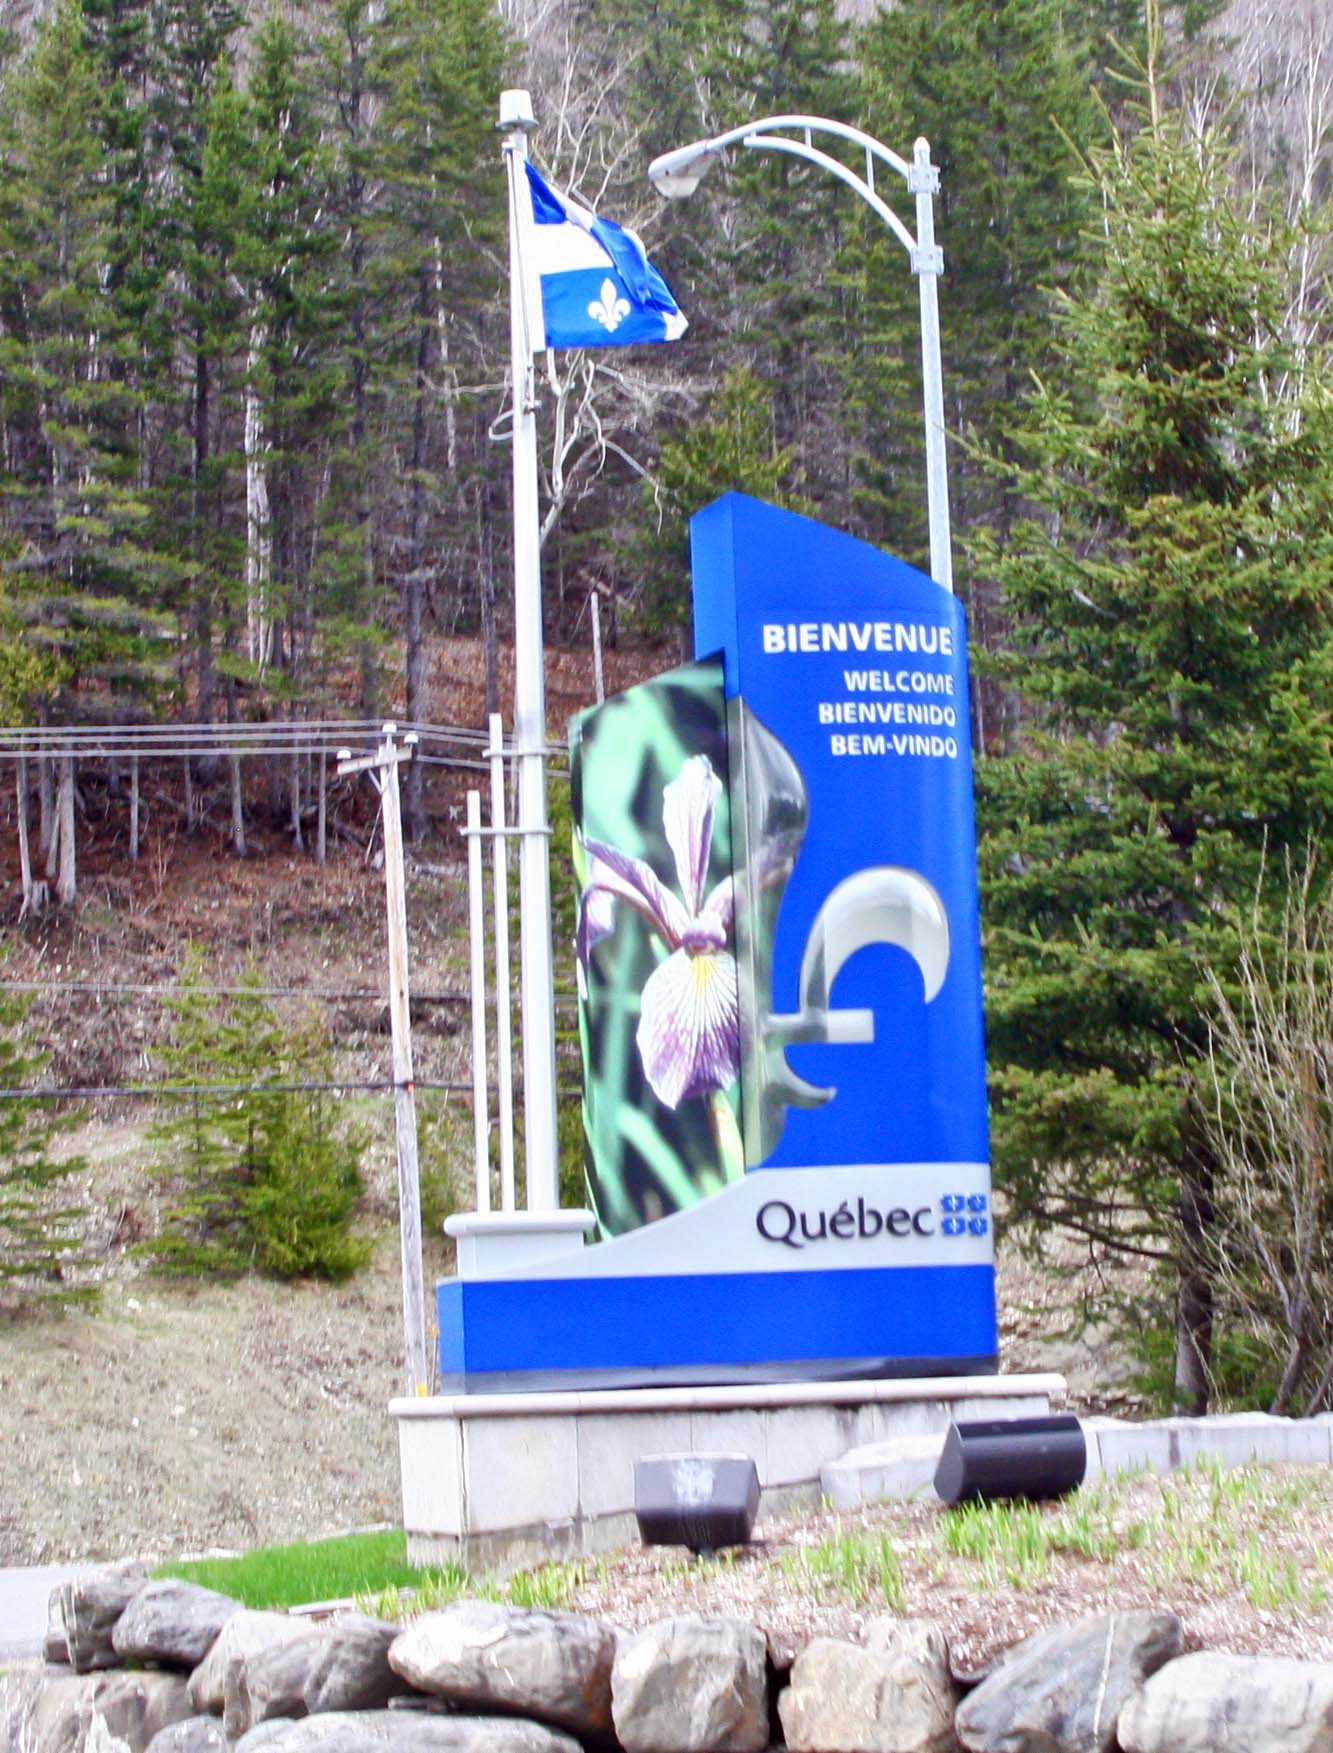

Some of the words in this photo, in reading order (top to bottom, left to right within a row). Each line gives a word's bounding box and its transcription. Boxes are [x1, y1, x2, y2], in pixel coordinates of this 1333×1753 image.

[763, 622, 953, 656] BIENVENUE
[844, 670, 954, 695] WELCOME
[819, 702, 957, 728] BIENVENIDO
[831, 733, 958, 759] BEM-VINDO
[756, 1197, 934, 1249] Québec
